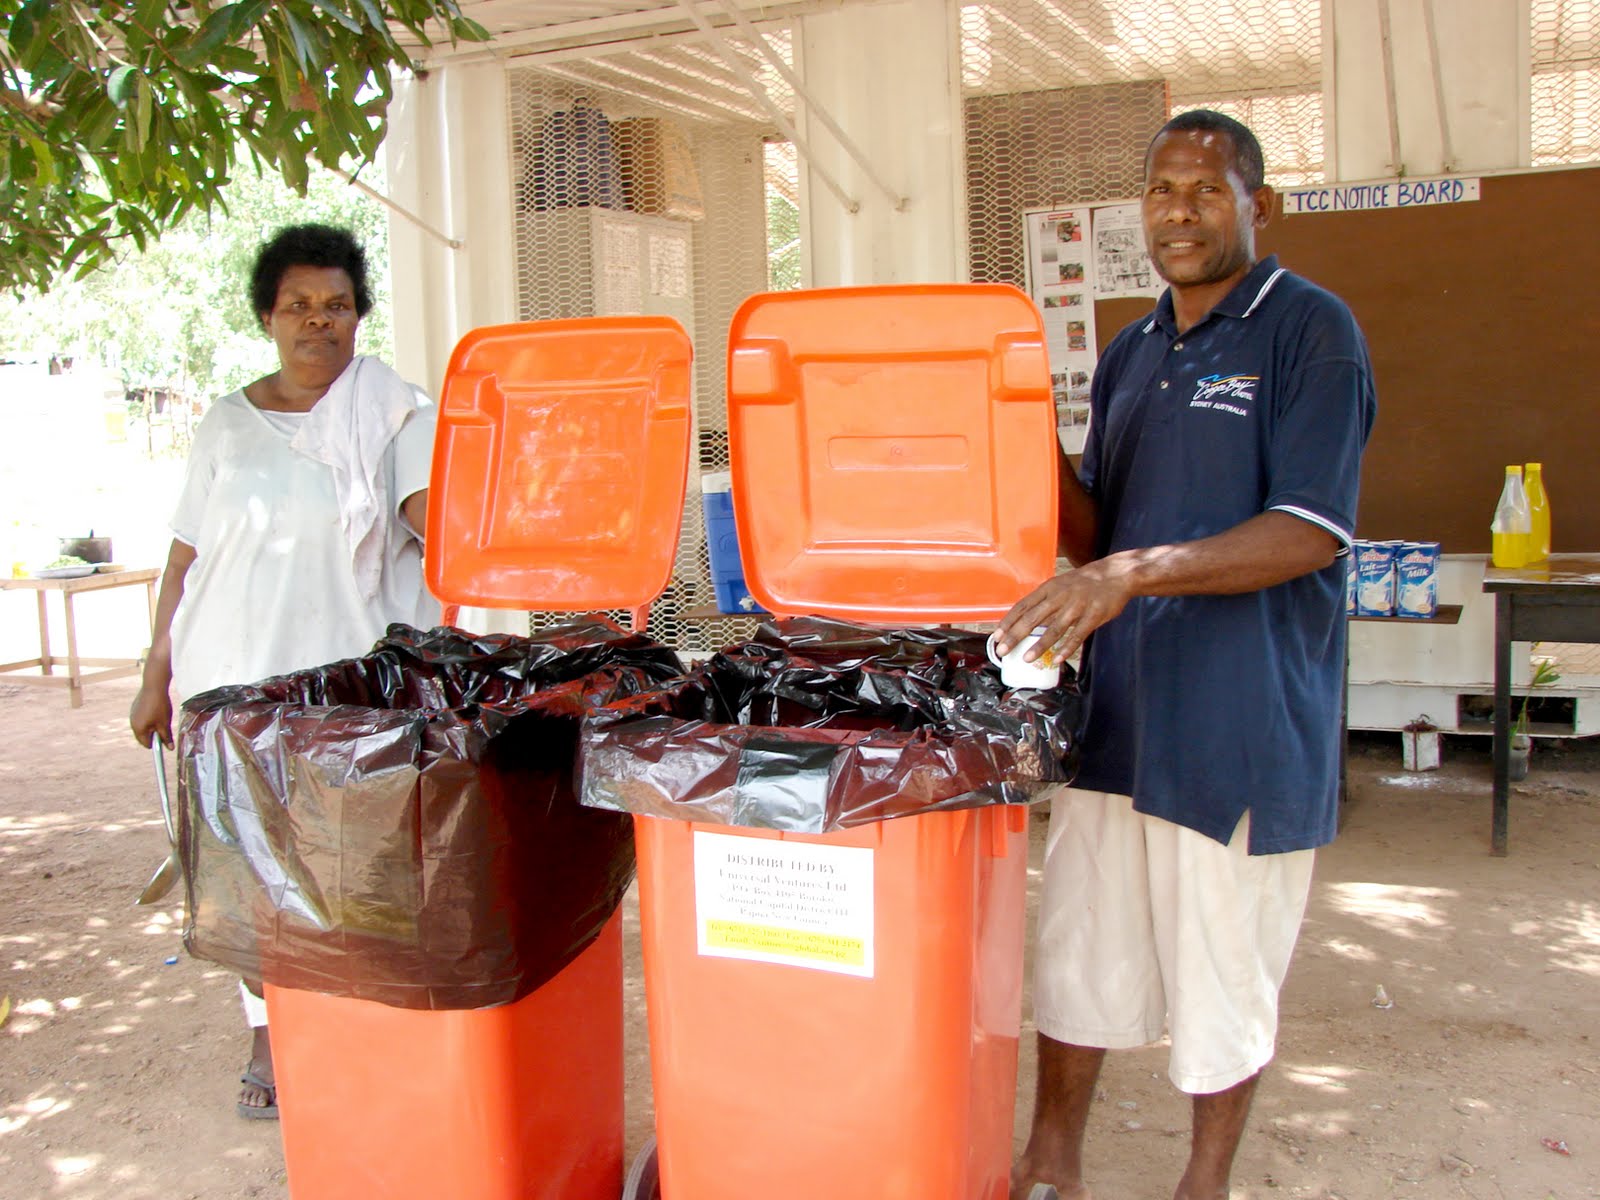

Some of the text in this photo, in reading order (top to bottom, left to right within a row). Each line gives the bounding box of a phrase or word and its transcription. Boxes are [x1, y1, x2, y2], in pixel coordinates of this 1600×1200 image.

[1289, 179, 1465, 212] TCC NOTICE BOARD
[1189, 399, 1248, 417] SYDNEY AUSTRALIA
[1360, 562, 1376, 572] Lait
[1407, 567, 1429, 578] Milk
[726, 852, 836, 875] DISTRIBUTED BY
